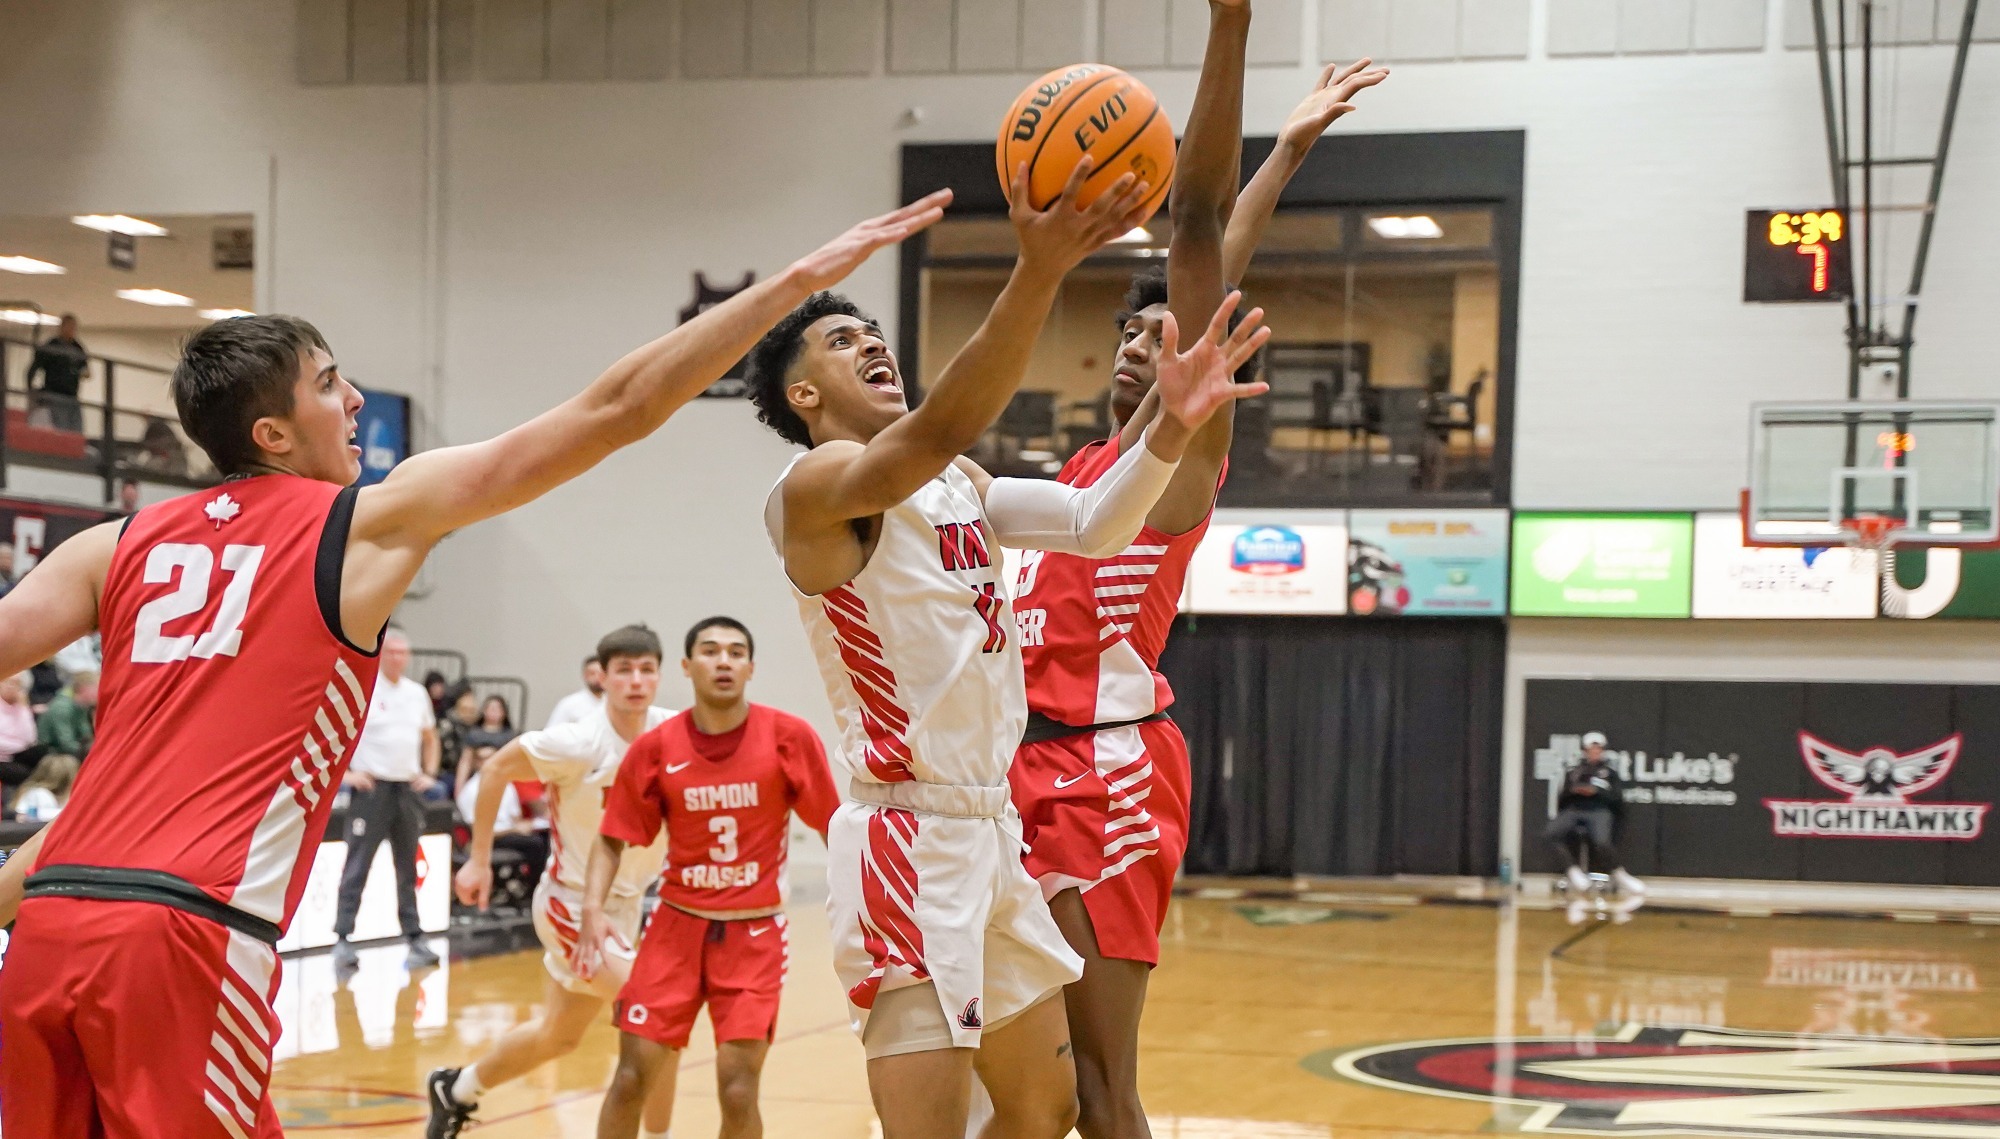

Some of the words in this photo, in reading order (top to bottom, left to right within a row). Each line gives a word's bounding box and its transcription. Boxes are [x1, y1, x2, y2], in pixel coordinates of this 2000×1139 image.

[1074, 94, 1127, 152] EVO
[1769, 211, 1841, 246] 6:39
[1797, 243, 1829, 293] 7
[130, 542, 266, 664] 21
[971, 581, 1007, 654] 11
[1015, 608, 1047, 648] SER
[1634, 750, 1735, 785] Luke's
[683, 781, 759, 812] SIMON
[1655, 785, 1737, 806] Medicine
[1780, 807, 1975, 832] NIGHTHAWKS
[708, 815, 739, 863] 3
[681, 861, 760, 890] FRASER
